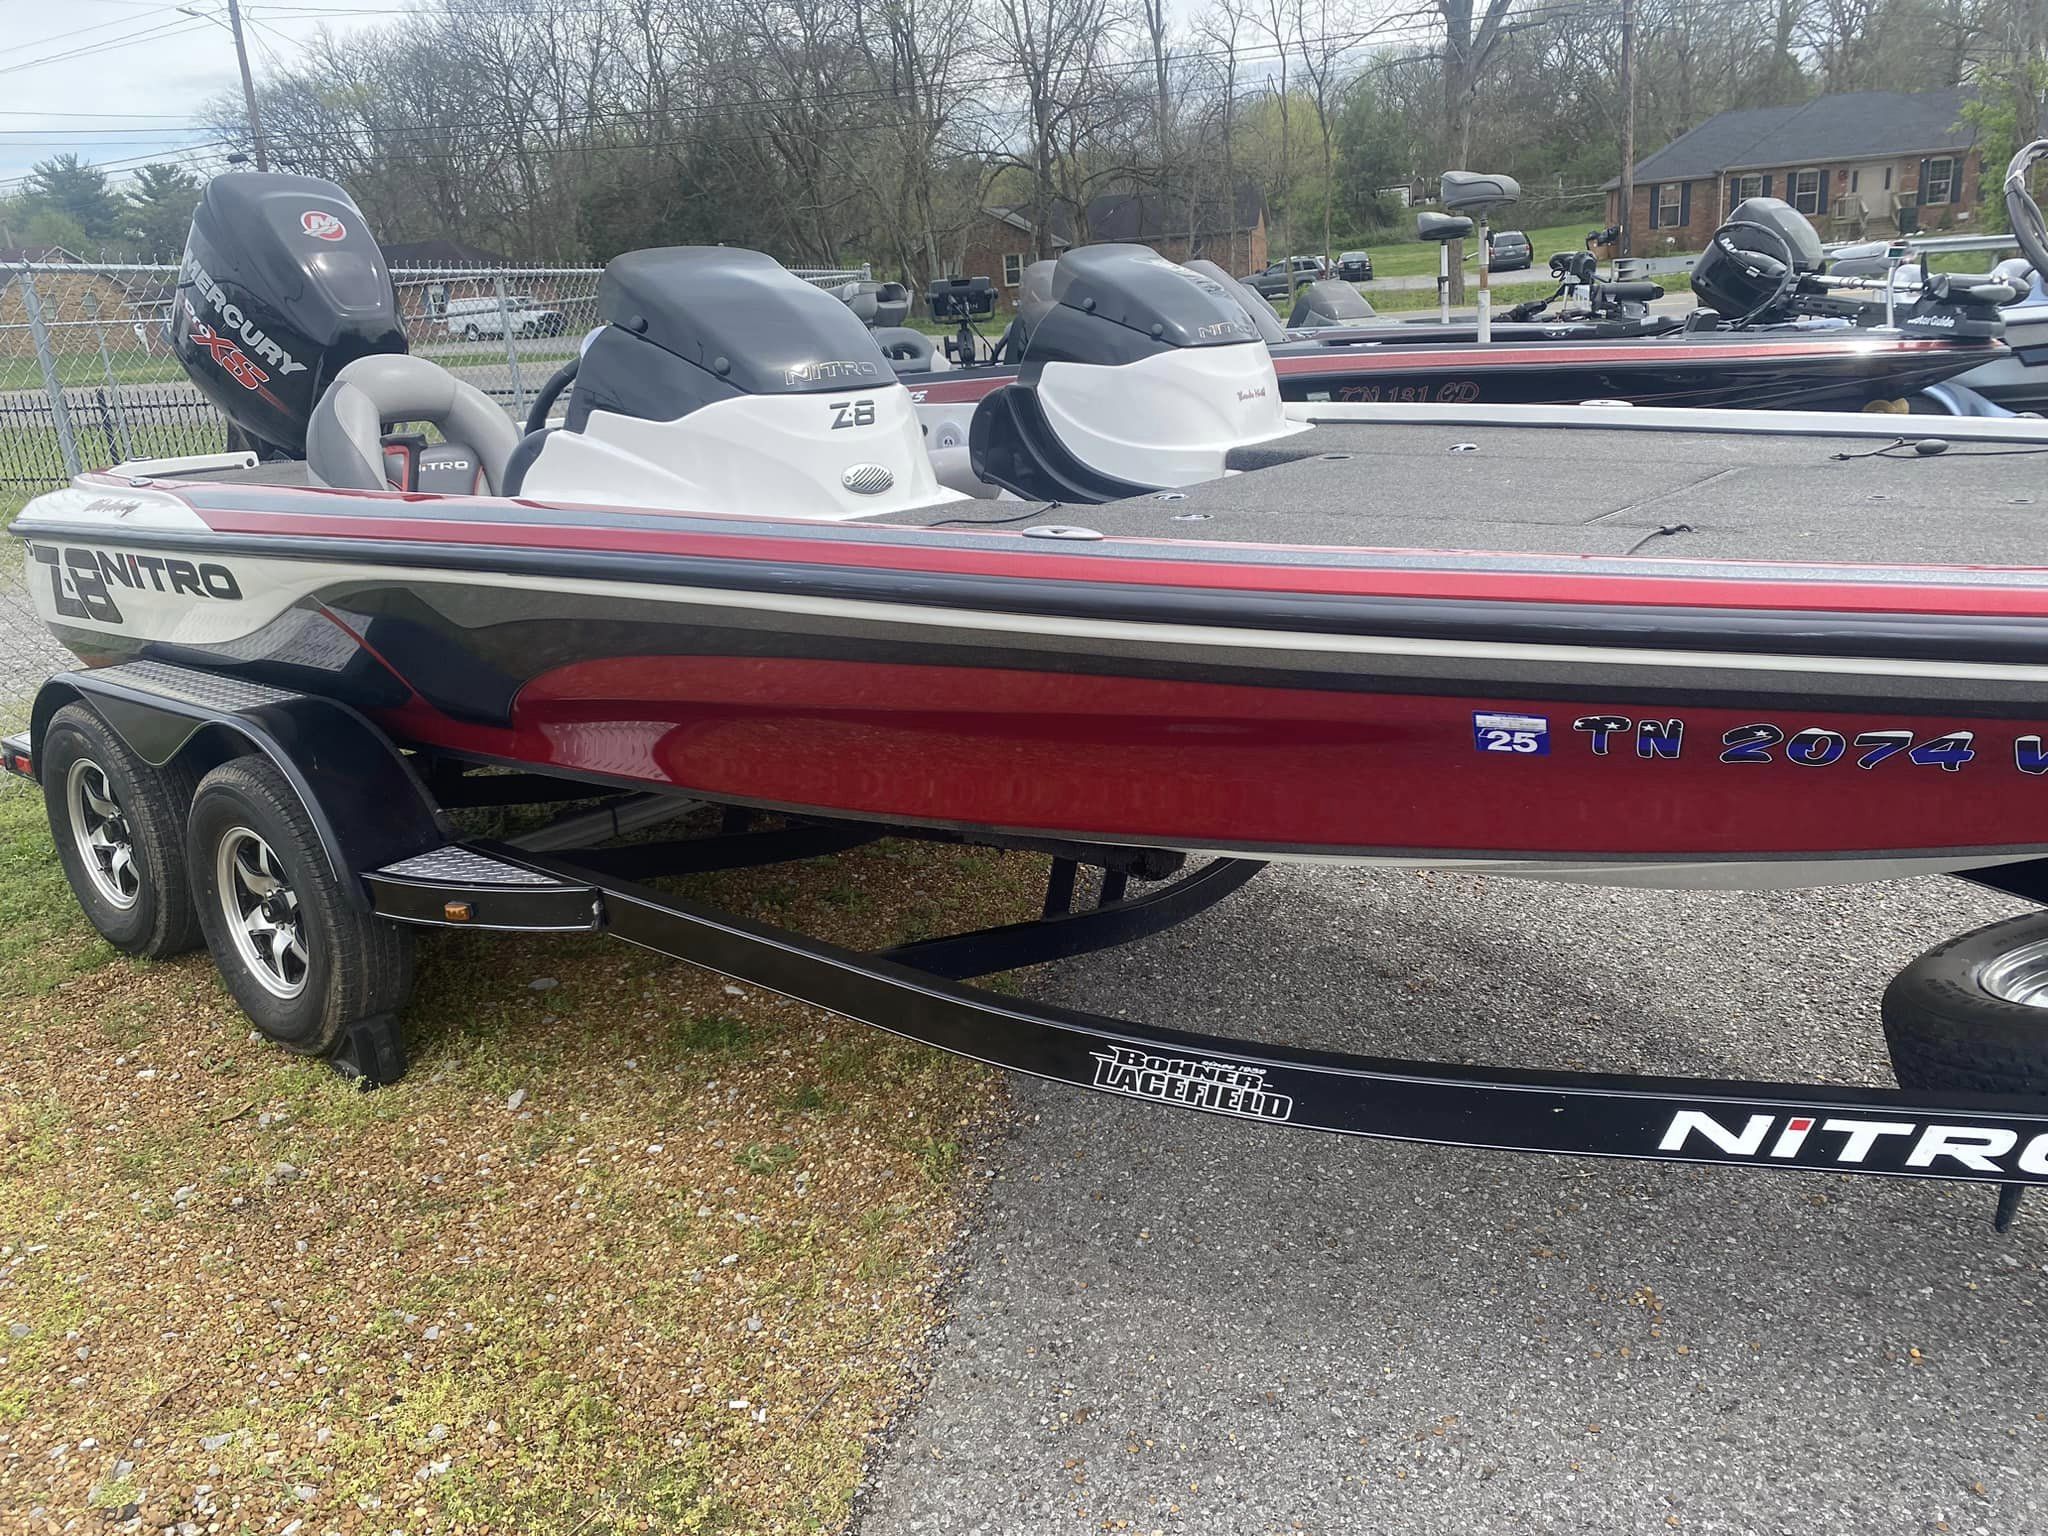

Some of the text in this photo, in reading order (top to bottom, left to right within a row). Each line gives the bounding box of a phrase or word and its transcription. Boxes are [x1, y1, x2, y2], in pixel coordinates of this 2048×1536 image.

[184, 248, 308, 375] MERCURY
[189, 324, 270, 390] XS
[784, 360, 878, 386] NITRO
[96, 550, 243, 600] NITRO
[1487, 730, 1538, 752] 25
[1573, 714, 1684, 759] TN
[1719, 722, 1976, 773] 2074
[1093, 1056, 1293, 1121] LACEFIELD
